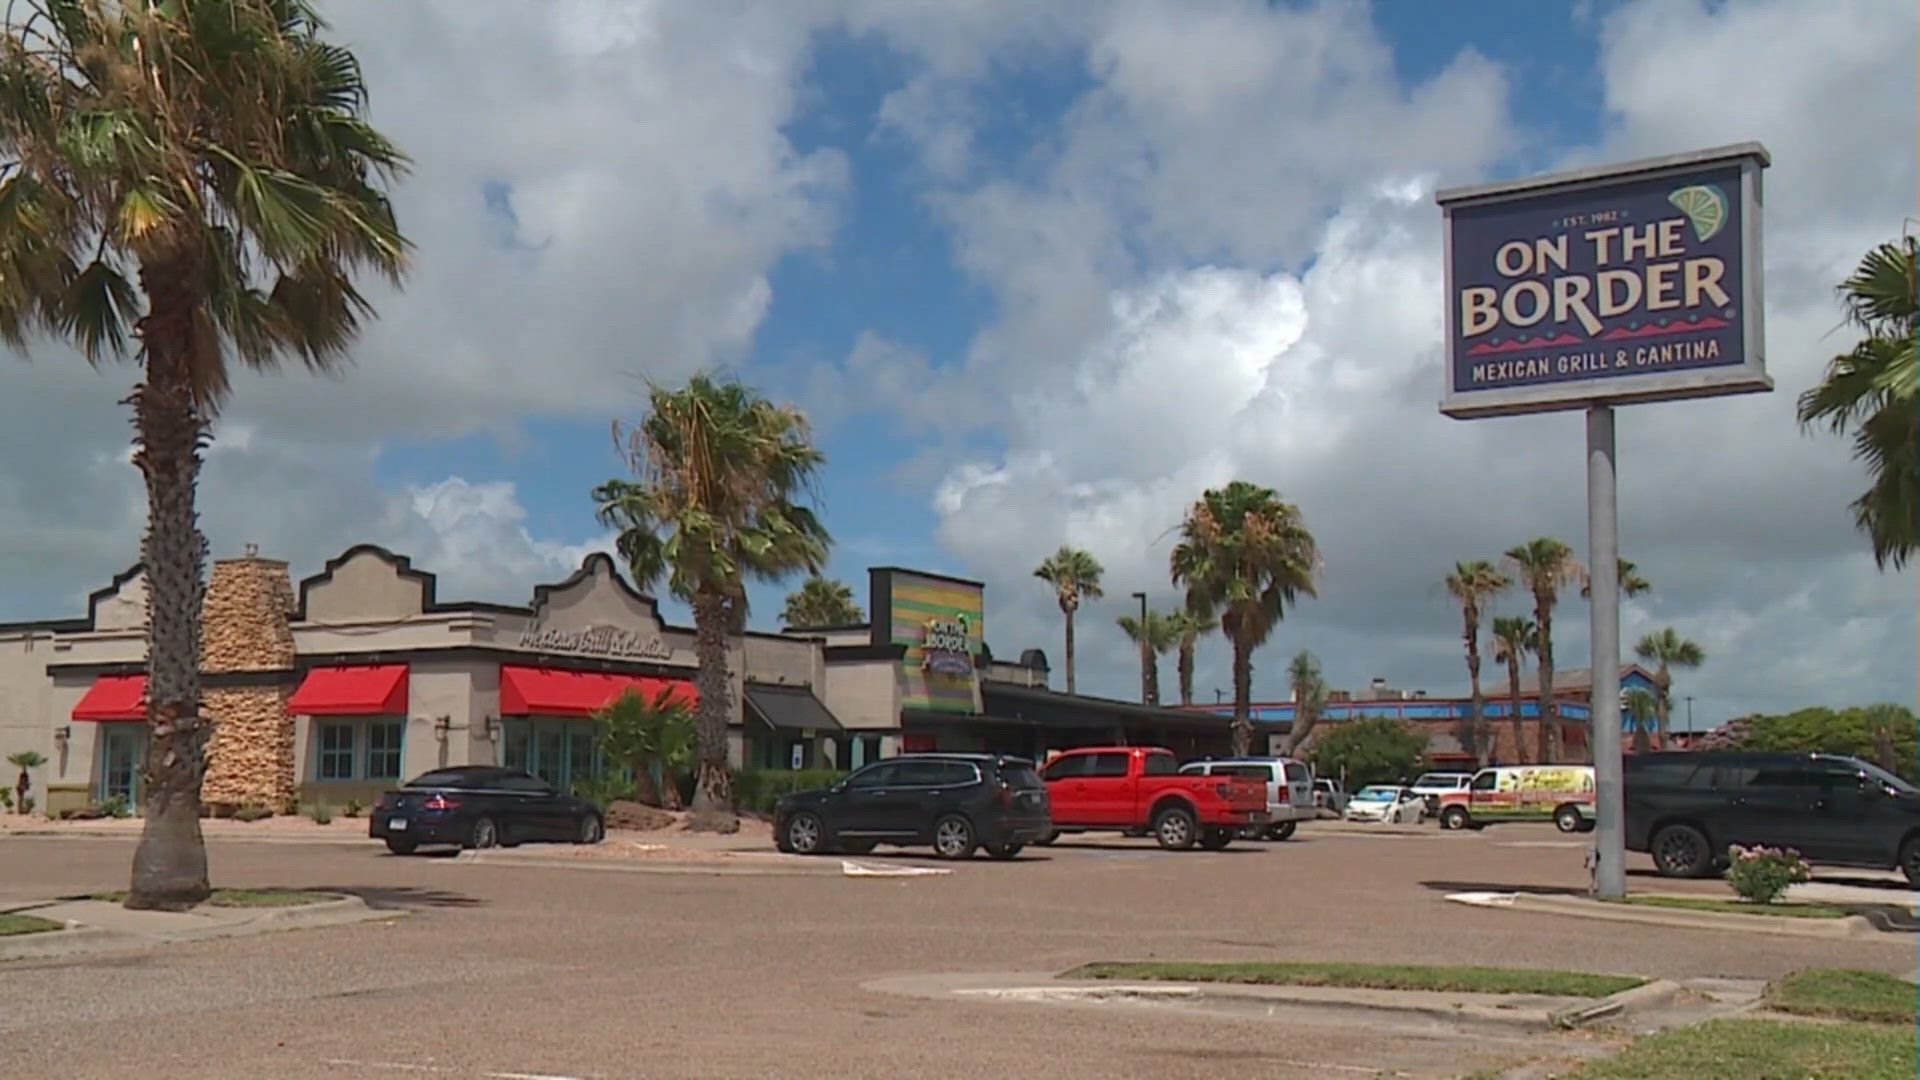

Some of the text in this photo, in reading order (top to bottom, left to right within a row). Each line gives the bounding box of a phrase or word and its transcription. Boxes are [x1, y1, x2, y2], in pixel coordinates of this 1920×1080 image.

[1591, 211, 1618, 223] 1982
[1496, 218, 1686, 277] ON THE
[1461, 256, 1731, 337] BORDER
[1472, 339, 1720, 383] MEXICAN GRILL & CANTINA
